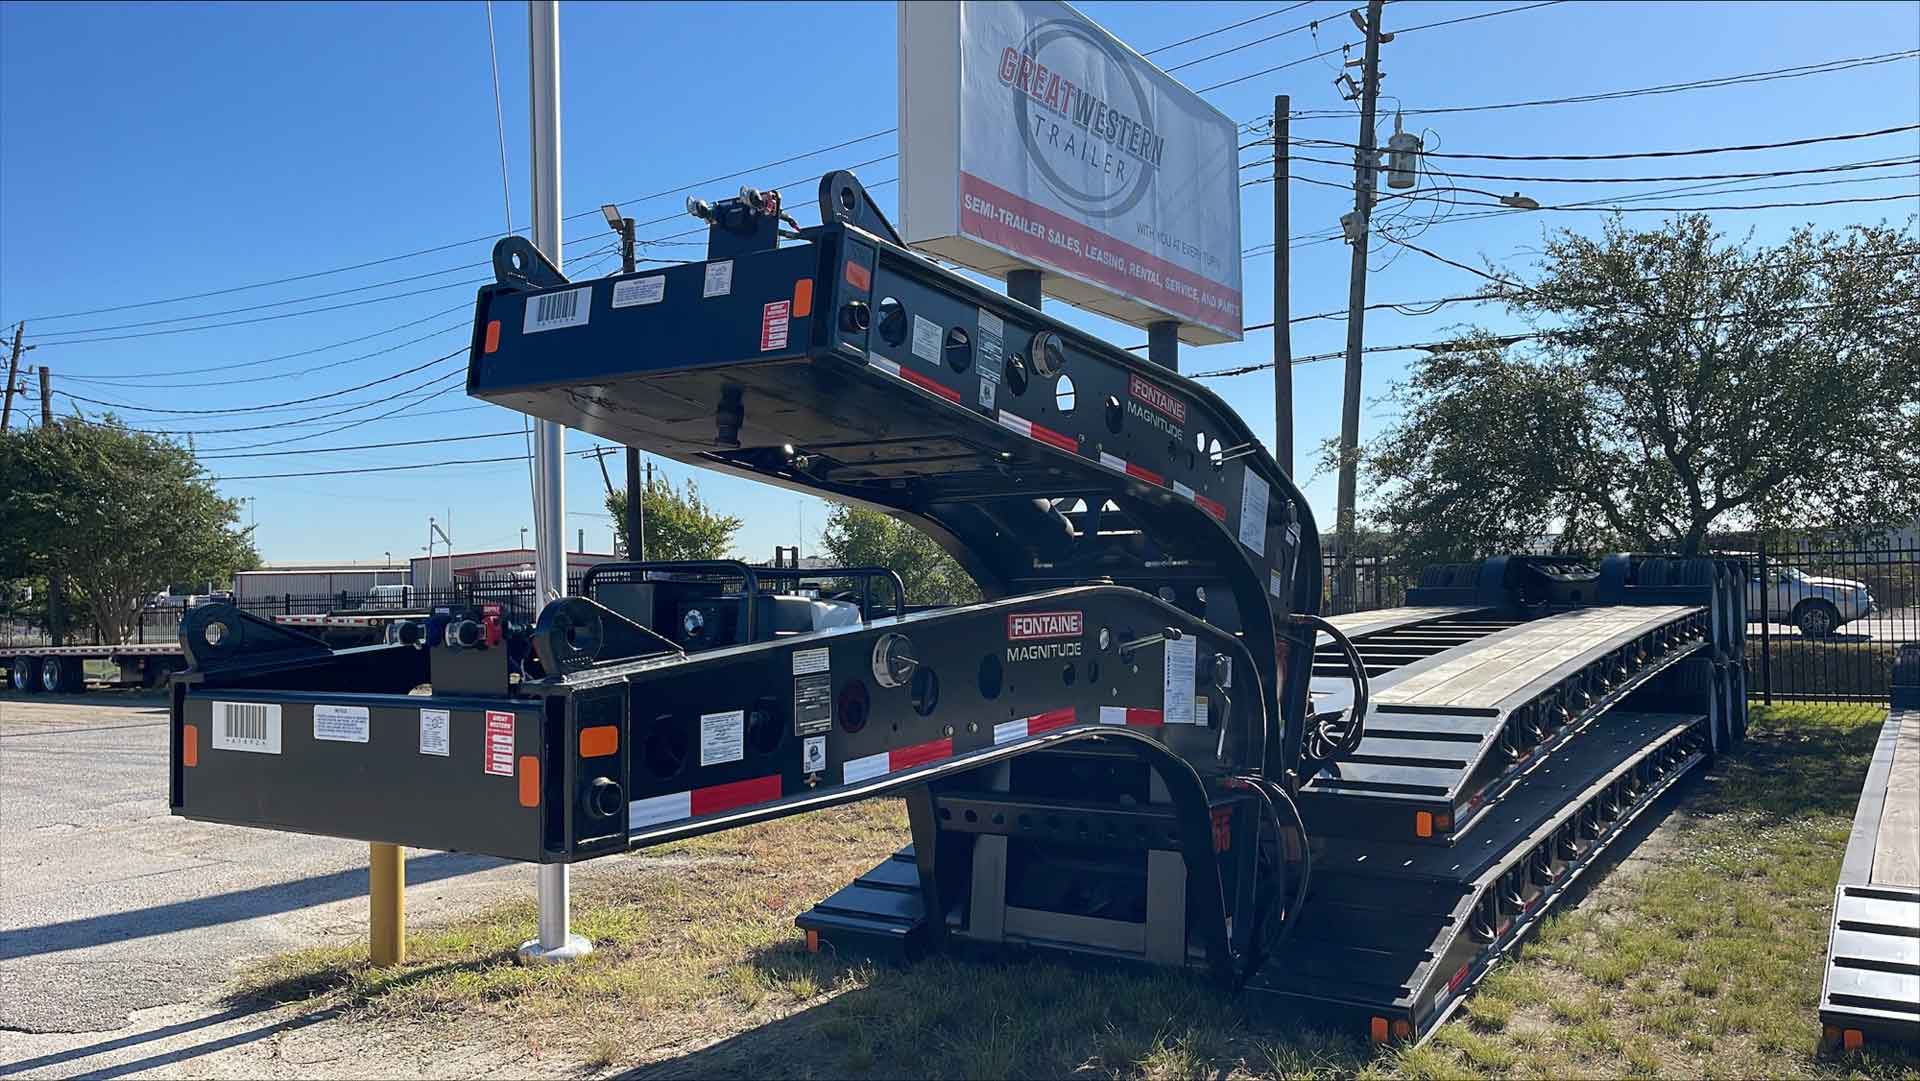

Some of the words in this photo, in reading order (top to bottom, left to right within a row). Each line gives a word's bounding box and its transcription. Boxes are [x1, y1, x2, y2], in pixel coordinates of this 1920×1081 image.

[1034, 115, 1126, 182] TRAILER
[964, 194, 1045, 239] SEMI-TRAILER
[1048, 229, 1082, 257] SALES,
[1085, 244, 1126, 275] LEASING,
[1135, 379, 1183, 418] FONTAINE
[1127, 400, 1184, 441] MAGNITUDE
[1014, 615, 1079, 635] FONTAINE
[1007, 642, 1082, 662] MAGNITUDE
